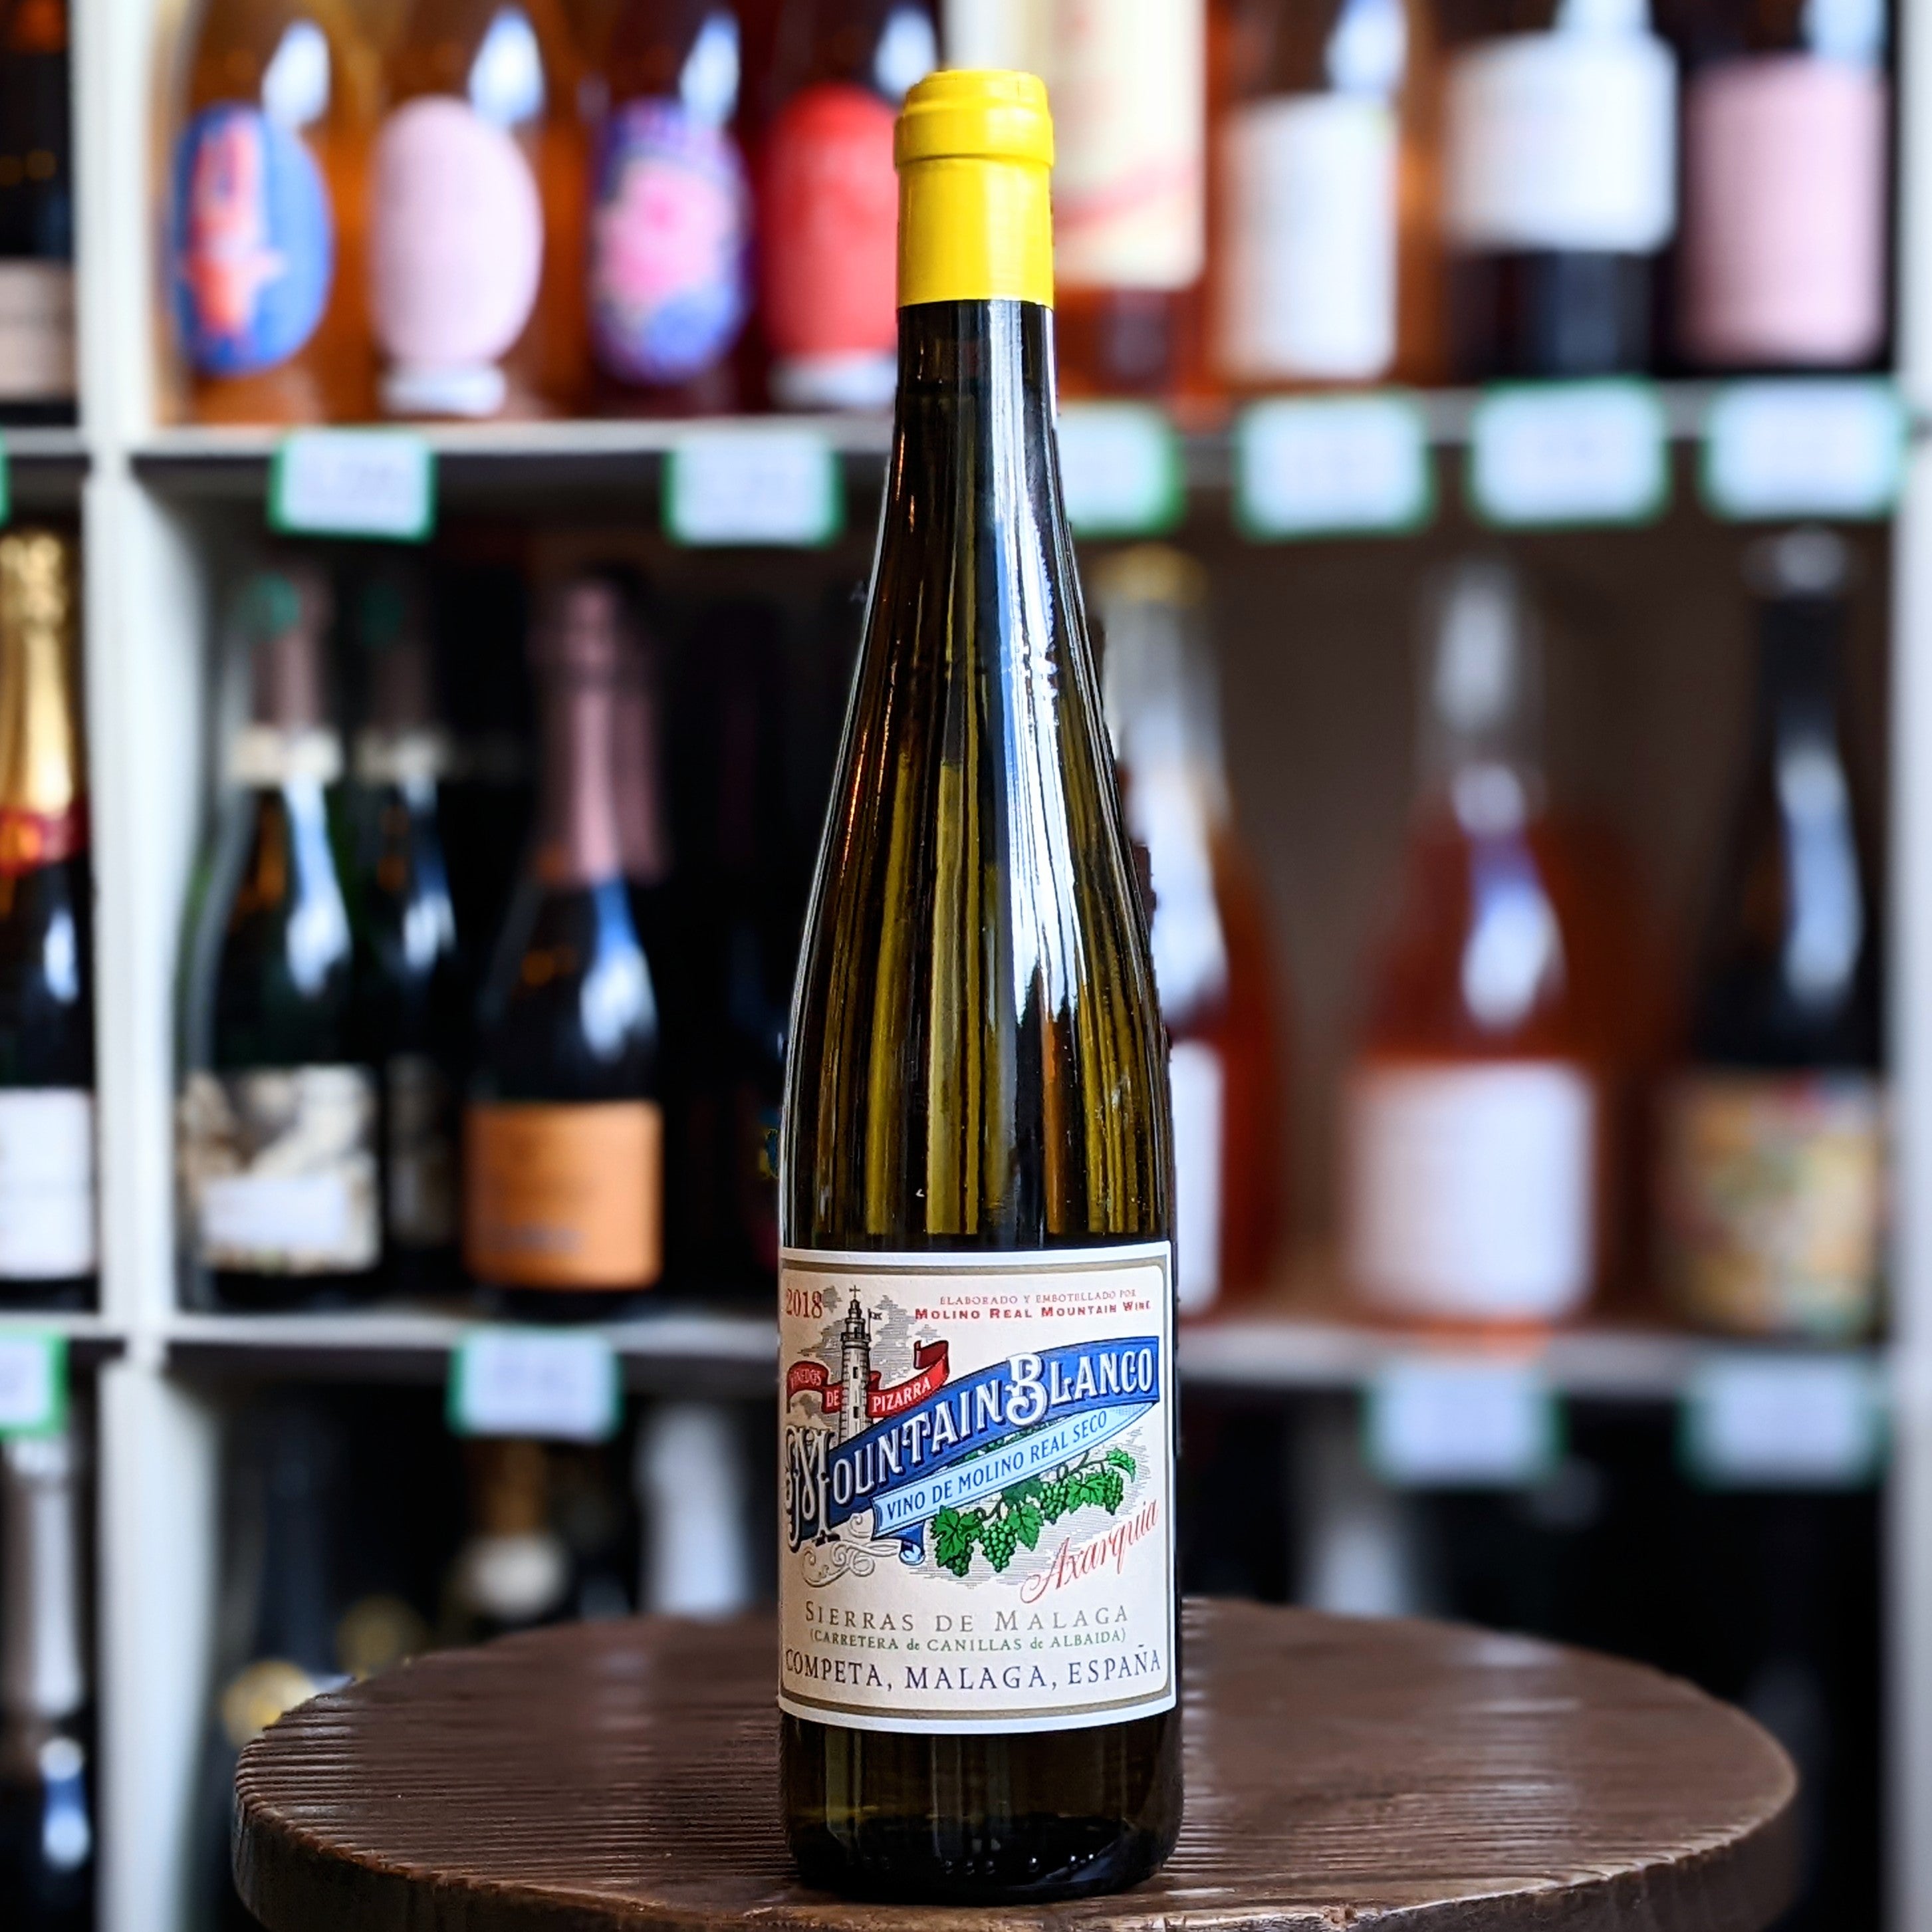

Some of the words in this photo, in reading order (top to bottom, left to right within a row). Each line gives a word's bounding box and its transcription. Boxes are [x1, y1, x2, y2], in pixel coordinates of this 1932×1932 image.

[786, 1288, 823, 1319] 2018
[915, 1308, 980, 1320] MOLINO
[989, 1308, 1032, 1319] REAL
[1041, 1304, 1117, 1318] MOUNTAIN
[940, 1296, 1018, 1305] ELABORADO
[1024, 1294, 1030, 1304] Y
[1036, 1291, 1116, 1303] EMBOTELLADO
[1120, 1289, 1136, 1298] POR
[826, 1390, 840, 1407] DE
[873, 1377, 931, 1413] PIZARRA
[785, 1379, 1003, 1553] MOUNTAIN
[1005, 1346, 1153, 1426] BLANCO
[887, 1491, 925, 1520] VINO
[932, 1481, 953, 1503] DE
[958, 1451, 1024, 1495] MOLINO
[1030, 1433, 1068, 1464] REAL
[1072, 1410, 1107, 1444] SECO
[805, 1600, 914, 1631] SIERRAS
[935, 1615, 973, 1633] DE
[995, 1605, 1128, 1632] MALAGA
[810, 1628, 899, 1650] (CARRETERA
[906, 1638, 920, 1651] de
[927, 1638, 1023, 1651] CANILLAS
[1030, 1637, 1043, 1649] de
[1049, 1628, 1126, 1649] ALBAIDA)
[785, 1648, 892, 1692] COMPETA,
[904, 1665, 1057, 1691] MALAGA,
[1068, 1644, 1161, 1685] ESPAÑA
